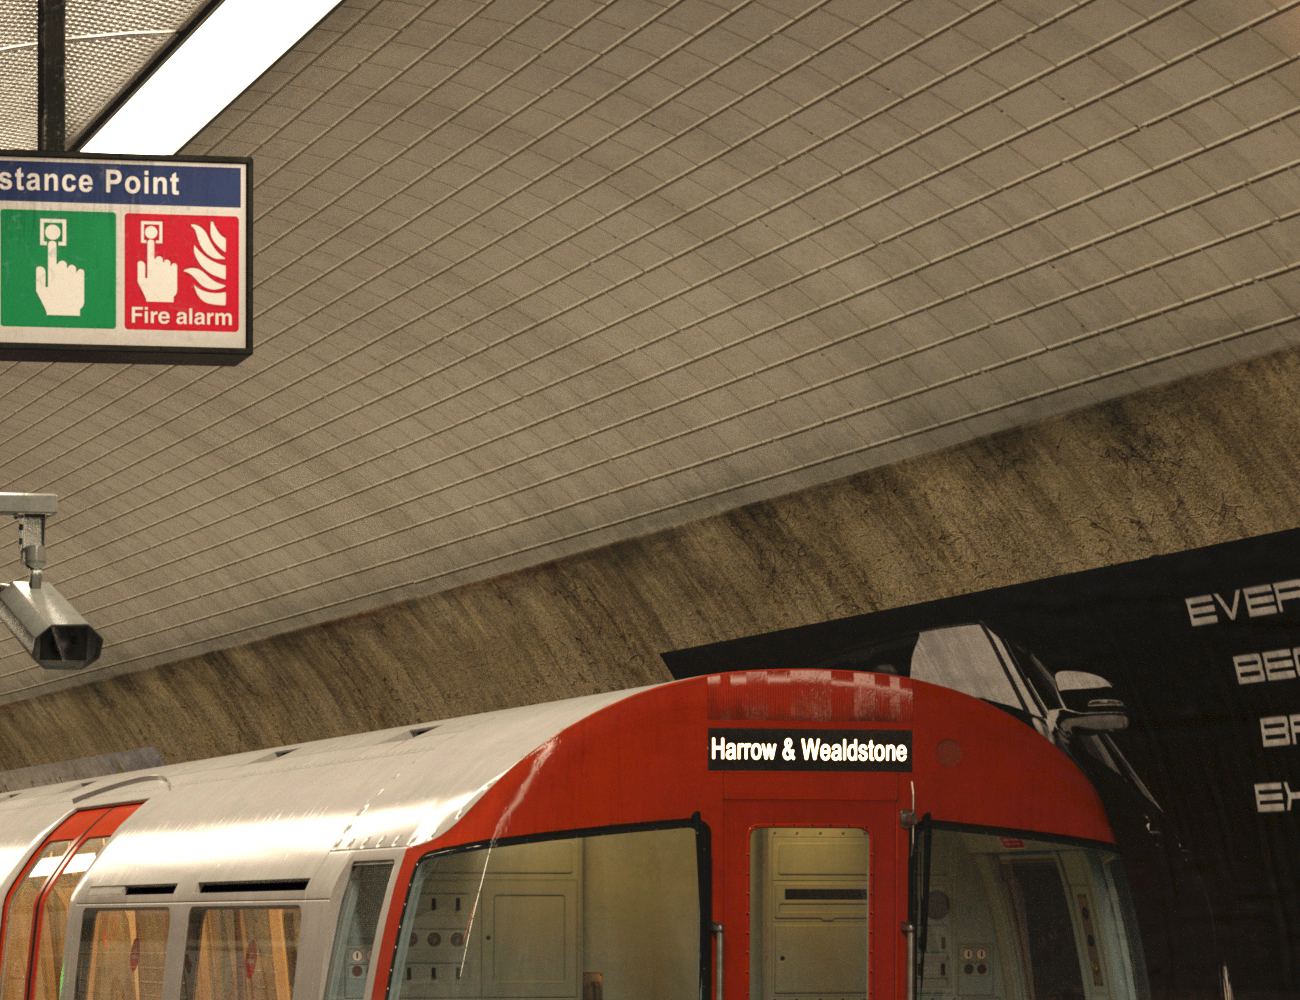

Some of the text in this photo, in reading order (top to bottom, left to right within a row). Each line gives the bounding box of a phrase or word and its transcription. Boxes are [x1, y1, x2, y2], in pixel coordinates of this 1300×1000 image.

[105, 169, 181, 196] Point
[130, 306, 234, 328] Fire alarm
[711, 736, 908, 763] Harrow & Wealdstone
